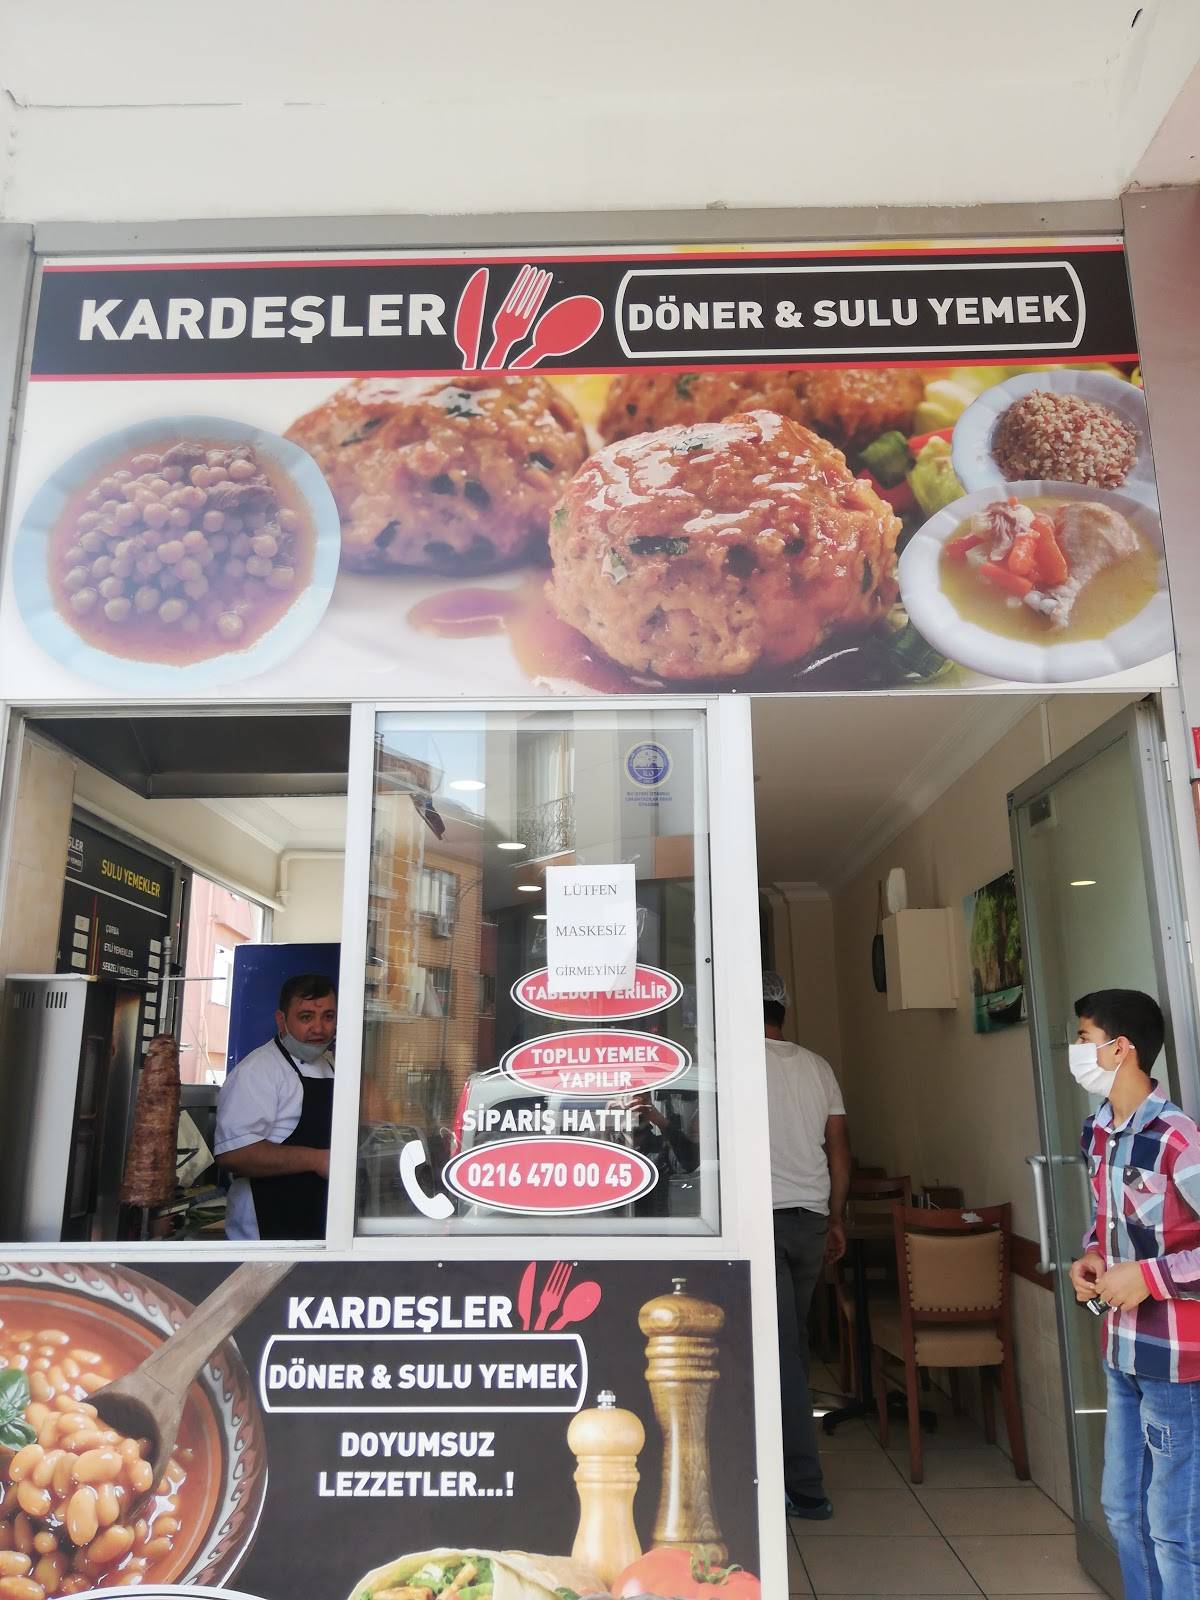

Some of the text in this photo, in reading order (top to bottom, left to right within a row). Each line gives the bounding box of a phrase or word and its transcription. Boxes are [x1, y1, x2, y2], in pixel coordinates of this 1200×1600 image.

[79, 292, 447, 344] KARDEŞLER
[628, 293, 1074, 332] DÖNER & SULU YEMEK
[101, 859, 123, 881] SULU
[123, 868, 161, 897] YEMEKLER
[563, 882, 618, 897] LÜTFEN
[556, 923, 627, 937] MASKESİZ
[556, 963, 627, 977] GİRMEYİNİZ
[605, 981, 667, 1000] VERİLİR
[531, 1046, 660, 1065] TOPLU YEMEK
[559, 1071, 632, 1088] YAPILIR
[462, 1103, 632, 1134] SİPARİŞ HATTI
[468, 1163, 632, 1187] 0216 470 00 45
[288, 1295, 513, 1333] KARDEŞLER
[268, 1357, 578, 1389] DÖNER & SULU YEMEK
[341, 1431, 495, 1457] DOYUMSUZ
[318, 1471, 515, 1497] LEZZETLER...!
